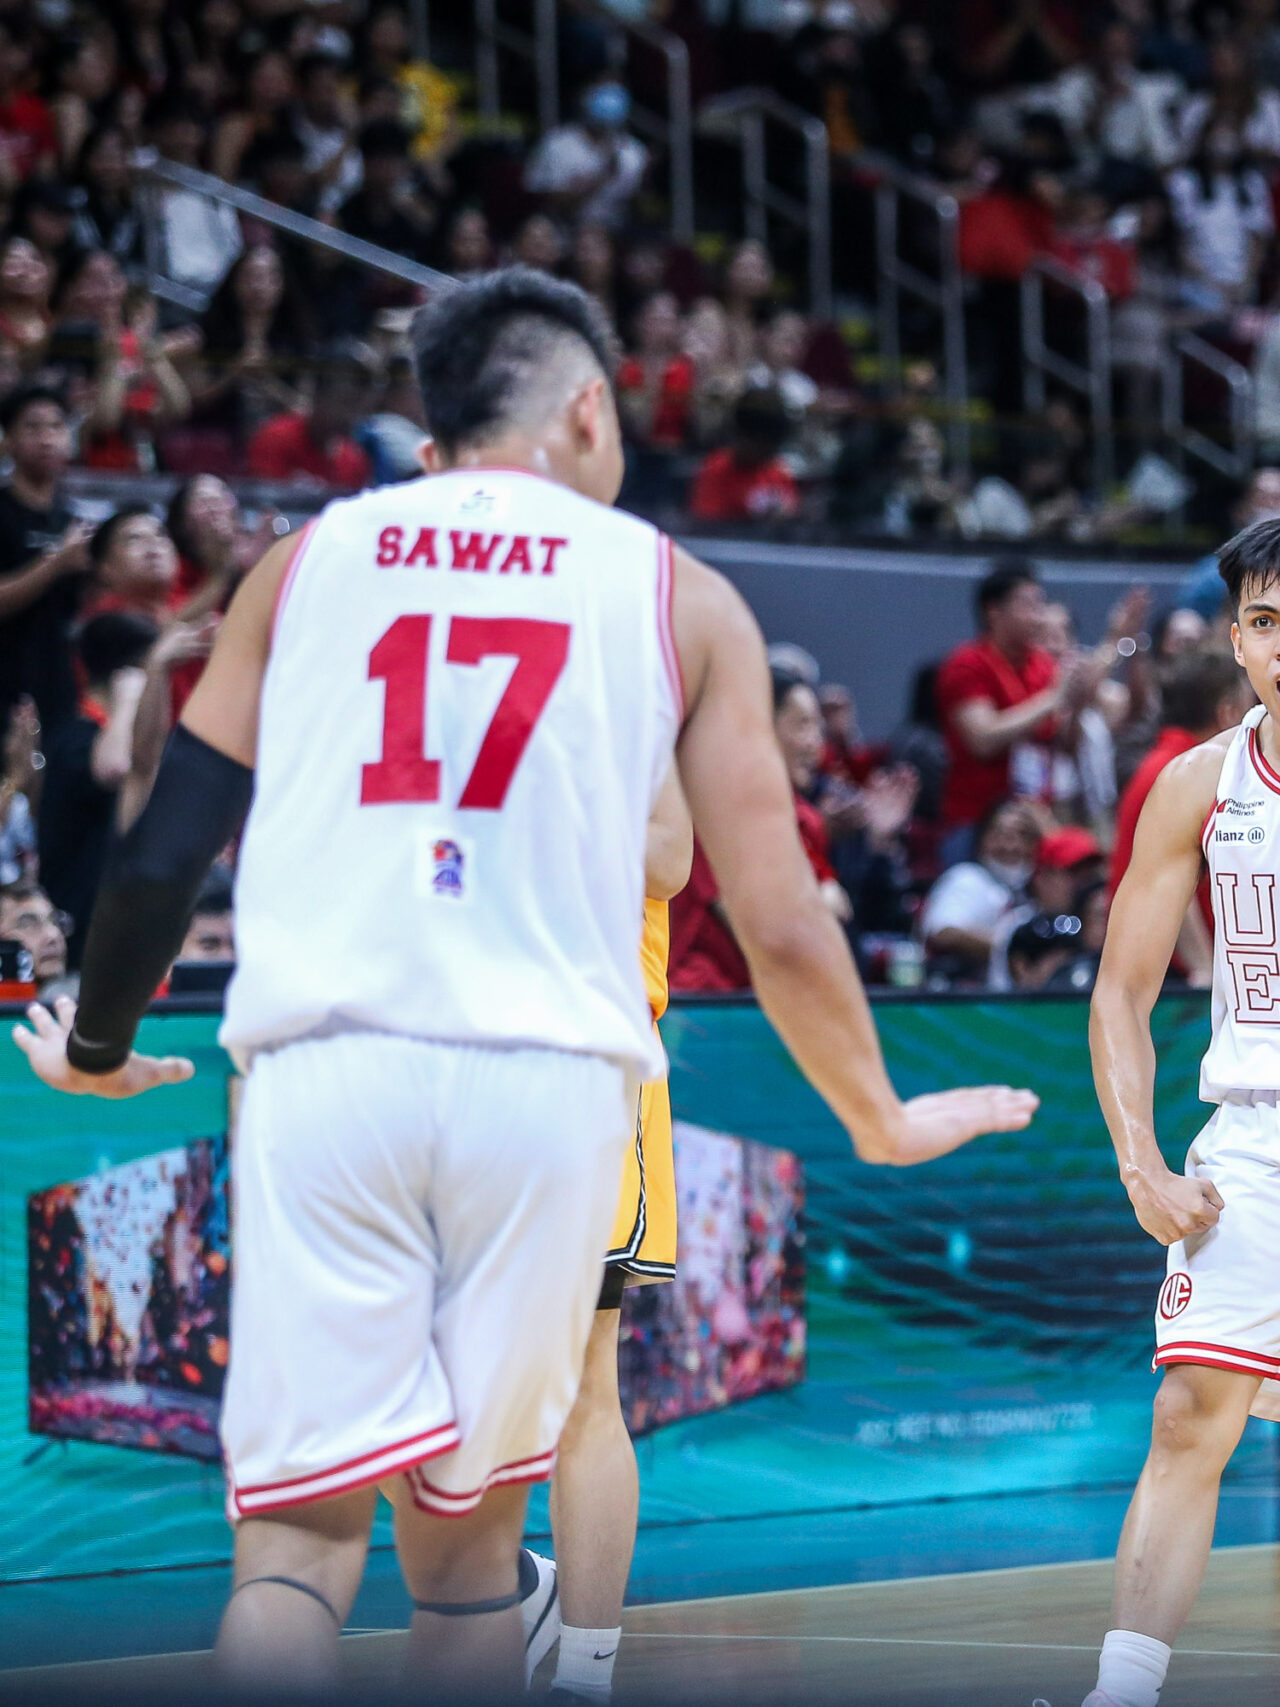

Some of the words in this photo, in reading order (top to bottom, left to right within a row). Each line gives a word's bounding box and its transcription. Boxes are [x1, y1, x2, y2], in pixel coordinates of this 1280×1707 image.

[376, 526, 569, 575] SAWAT
[360, 614, 571, 811] 17
[1226, 807, 1255, 817] Airlines
[1227, 798, 1265, 810] Philippine
[1216, 873, 1276, 947] U
